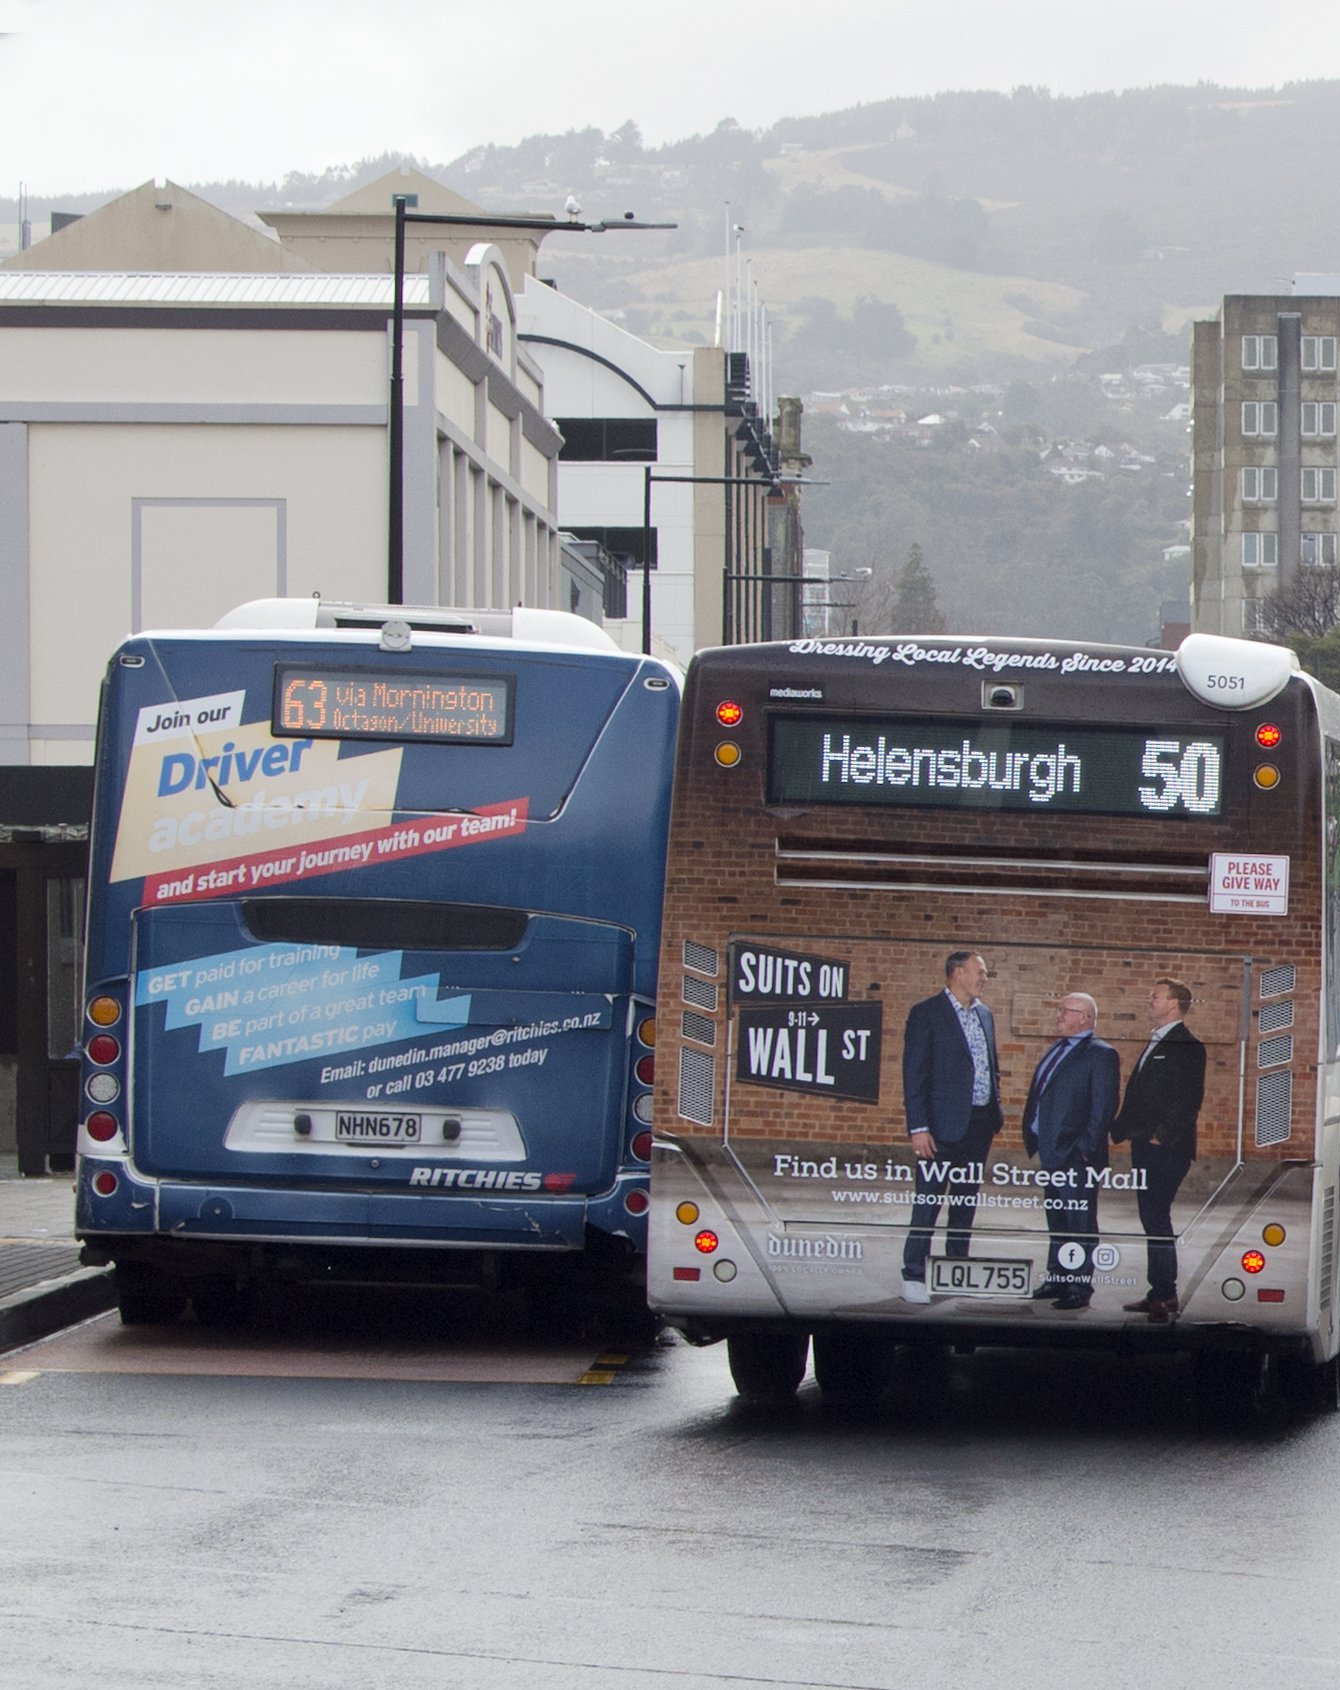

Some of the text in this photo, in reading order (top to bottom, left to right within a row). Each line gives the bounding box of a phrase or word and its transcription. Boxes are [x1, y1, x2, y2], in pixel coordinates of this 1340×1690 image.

[788, 638, 1178, 674] Dressing Local Legends Since 2014
[336, 682, 494, 711] via Mornington
[769, 687, 823, 699] mediaworks
[1207, 675, 1246, 690] 5051
[146, 705, 231, 733] Join our
[284, 680, 328, 730] 63
[157, 739, 314, 798] Driver
[821, 732, 1220, 813] Helensburgh 50
[148, 780, 369, 853] academy
[157, 808, 517, 899] and start your journey with our team!
[1227, 861, 1273, 876] PLEASE
[1222, 876, 1280, 891] GIVE WAY
[1230, 899, 1240, 907] TO
[1241, 899, 1254, 908] THE
[148, 943, 341, 994] GET paid for training
[738, 951, 844, 998] SUITS ON
[184, 961, 380, 1016] GAIN a career for life
[211, 984, 427, 1041] BE part of a great team
[238, 1020, 398, 1066] FANTASTIC pay
[320, 1011, 602, 1085] Email: dunedin.manager@ritchies.co.nz
[748, 1026, 871, 1085] WALL ST
[366, 1047, 549, 1099] or call 03 477 9238 today
[338, 1116, 418, 1137] NHN678
[409, 1166, 543, 1190] RITCHIES
[773, 1154, 1148, 1191] Find us in Wall Street Mall
[831, 1190, 1089, 1212] www.suitsonwallstreet.co.nz
[767, 1232, 864, 1259] dunedin
[936, 1264, 1026, 1290] LQL755
[1038, 1273, 1138, 1286] SuitsOnWallStreet
